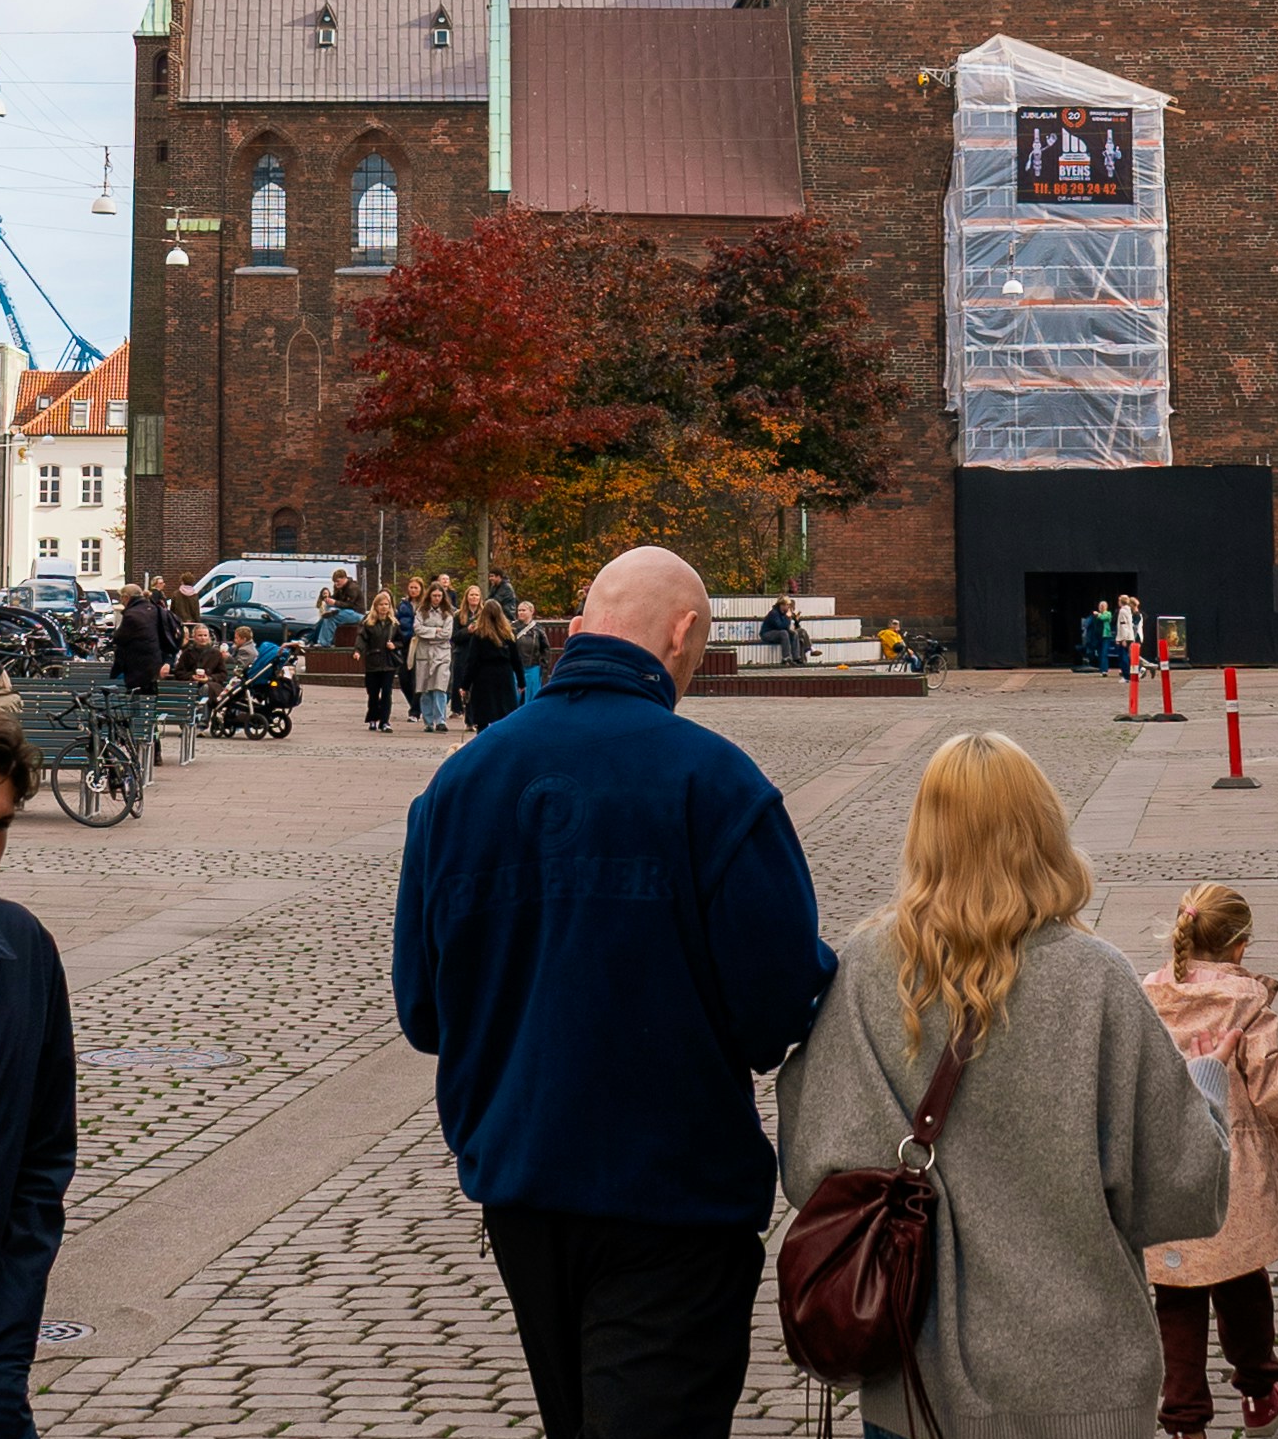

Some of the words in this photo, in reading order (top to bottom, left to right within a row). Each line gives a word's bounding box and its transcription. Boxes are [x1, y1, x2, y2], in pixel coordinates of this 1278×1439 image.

[1068, 112, 1081, 120] 20
[1059, 165, 1091, 177] BYENS
[1070, 183, 1085, 195] 29
[1087, 183, 1101, 195] 24
[1103, 183, 1117, 195] 42
